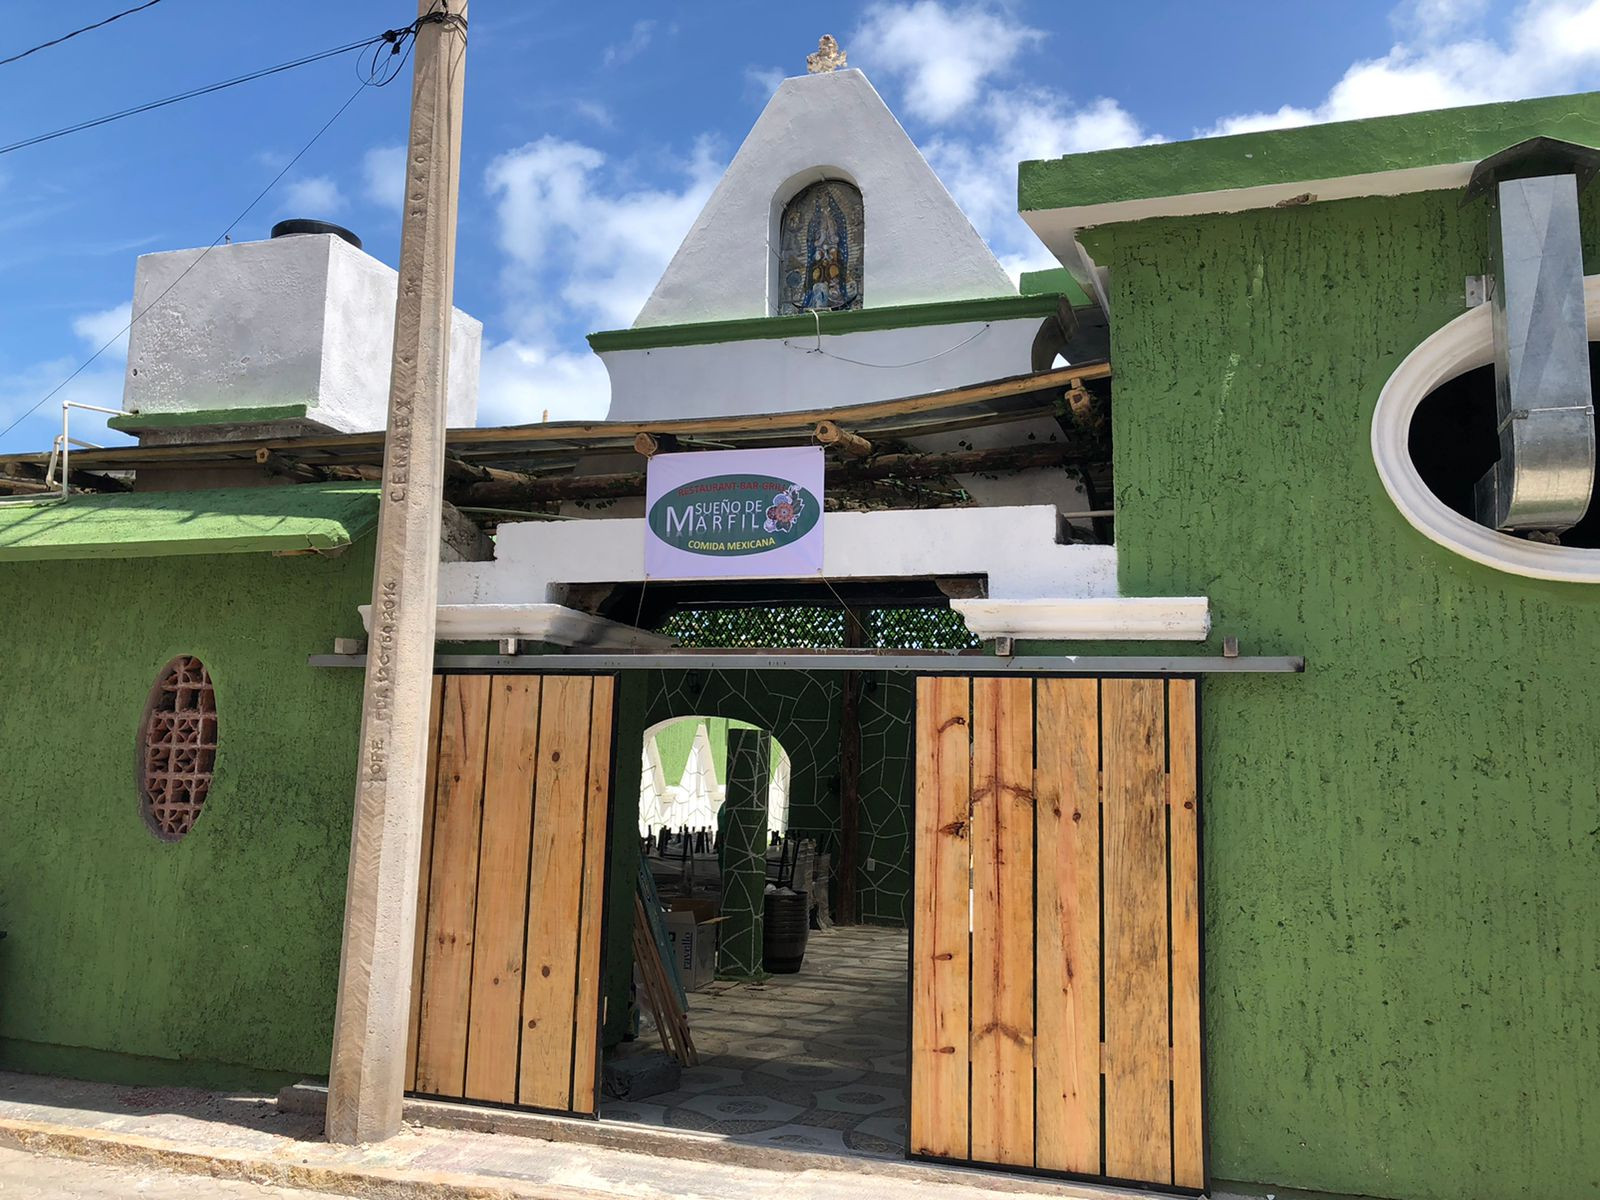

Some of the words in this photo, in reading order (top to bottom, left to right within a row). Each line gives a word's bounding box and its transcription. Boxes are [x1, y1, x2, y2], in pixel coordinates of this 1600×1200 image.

[678, 482, 736, 497] RESTAURANT
[740, 481, 759, 491] BAR
[695, 499, 741, 515] SUEÑO
[745, 500, 763, 513] DE
[666, 505, 760, 533] MARFIL
[688, 539, 725, 551] COMIDA
[726, 537, 776, 551] MEXICANA
